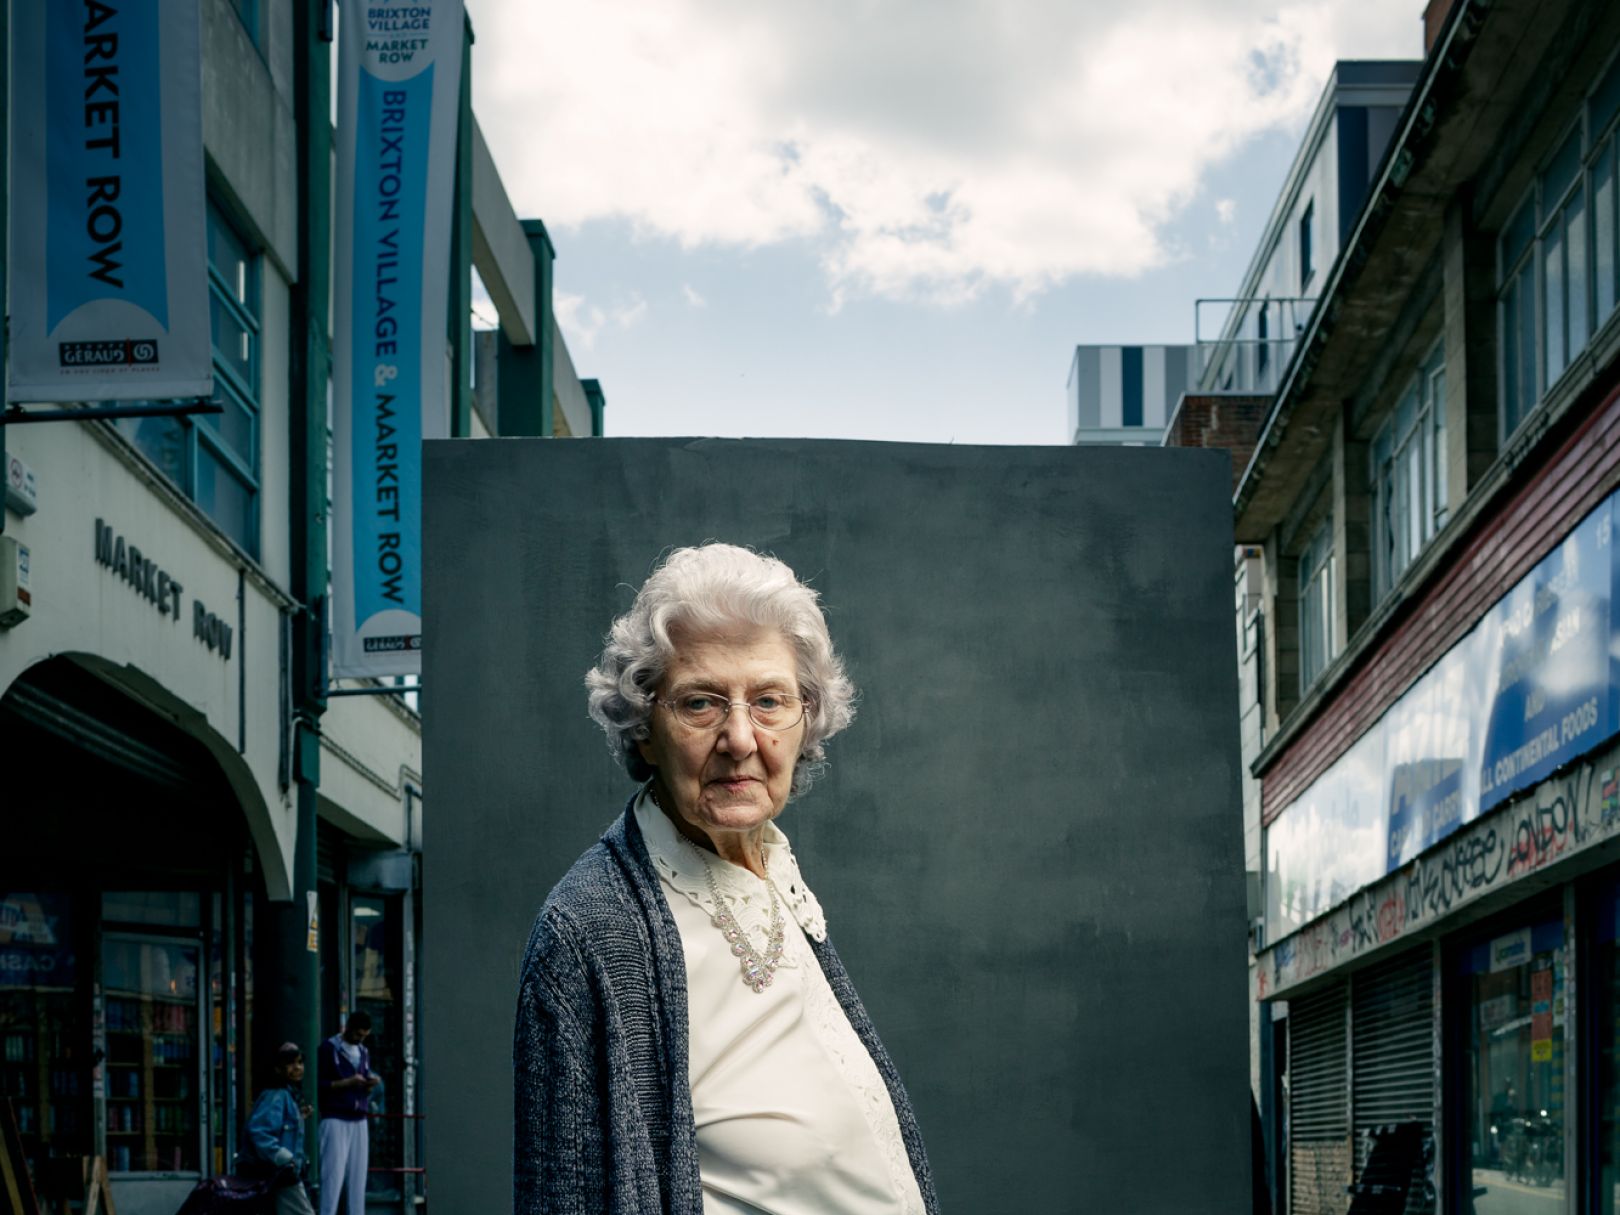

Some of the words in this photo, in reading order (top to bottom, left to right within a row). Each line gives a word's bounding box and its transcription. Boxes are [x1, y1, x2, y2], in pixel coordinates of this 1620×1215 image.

[366, 39, 429, 51] MARKET
[367, 7, 431, 19] BRIXTON
[368, 19, 430, 31] VILLAGE
[378, 52, 414, 63] ROW
[84, 0, 120, 159] ARKET
[379, 90, 406, 222] BRIXTON
[86, 175, 124, 289] ROW
[375, 230, 400, 357] VILLAGE
[374, 364, 398, 386] &
[375, 394, 400, 522] MARKET
[95, 518, 183, 623] MARKET
[193, 600, 233, 661] ROW
[378, 533, 405, 604] ROW
[1495, 724, 1560, 787] CONTINENTAL
[1562, 697, 1598, 746] FOODS
